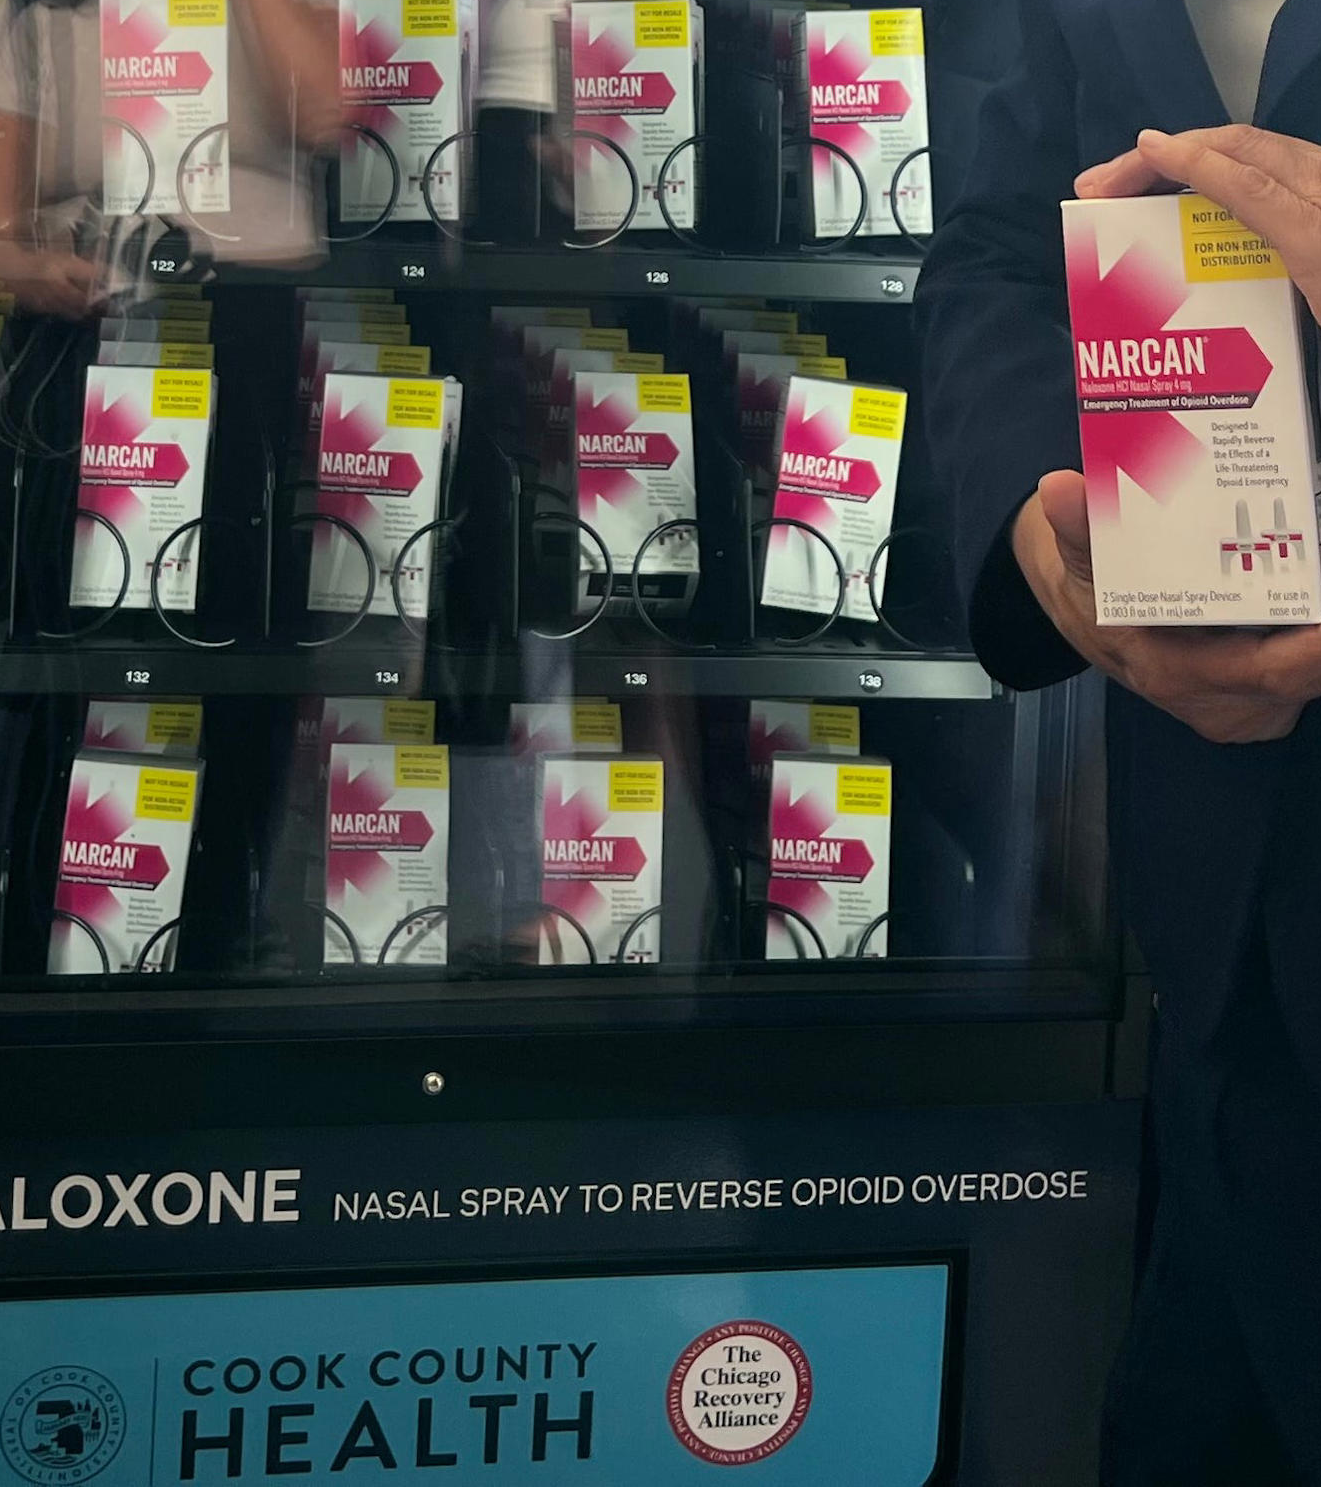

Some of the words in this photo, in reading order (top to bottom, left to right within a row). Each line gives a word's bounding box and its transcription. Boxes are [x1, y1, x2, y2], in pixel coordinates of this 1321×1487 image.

[104, 55, 177, 79] NARCAN
[341, 66, 411, 89] NARCAN
[574, 76, 643, 99] NARCAN
[811, 82, 881, 107] NARCAN
[1192, 212, 1211, 223] NOT
[1194, 243, 1214, 253] FOR
[150, 259, 175, 273] 122
[1201, 254, 1271, 267] DISTRIBUTION
[401, 265, 426, 279] 124
[646, 271, 670, 285] 126
[880, 280, 905, 293] 128
[1078, 337, 1206, 379] NARCAN
[1082, 381, 1115, 394] Naloxone
[1130, 380, 1151, 392] Nasal
[1152, 379, 1173, 393] Spray
[1180, 382, 1192, 393] mg
[1084, 399, 1128, 411] Emergency
[1129, 398, 1170, 408] Treatment
[1171, 396, 1180, 407] of
[1181, 395, 1208, 408] Opioid
[1210, 394, 1249, 406] Overdose
[1211, 421, 1248, 433] Designed
[1250, 422, 1259, 430] to
[579, 434, 647, 454] NARCAN
[1213, 435, 1242, 447] Rapidly
[1244, 435, 1275, 444] Reverse
[82, 444, 155, 469] NARCAN
[1214, 450, 1227, 458] the
[1229, 449, 1254, 458] Effects
[1256, 448, 1264, 457] of
[321, 451, 389, 476] NARCAN
[781, 451, 851, 481] NARCAN
[1216, 476, 1243, 488] Opioid
[1245, 477, 1288, 488] Emergency
[1160, 591, 1183, 602] Nasal
[1185, 591, 1208, 604] Spray
[1210, 591, 1243, 602] Devices
[1268, 589, 1282, 601] For
[1284, 592, 1298, 601] use
[1300, 590, 1309, 600] in
[1185, 605, 1204, 617] each
[1270, 608, 1289, 616] nose
[1292, 604, 1310, 618] only
[125, 670, 150, 684] 132
[375, 672, 400, 685] 134
[624, 673, 648, 686] 136
[858, 675, 882, 688] 138
[331, 813, 401, 834] NARCAN
[63, 840, 136, 869] NARCAN
[544, 840, 614, 863] NARCAN
[772, 838, 842, 863] NARCAN
[333, 1191, 450, 1222] NASAL
[459, 1186, 570, 1218] SPRAY
[579, 1184, 624, 1213] TO
[631, 1179, 784, 1212] REVERSE
[791, 1175, 904, 1206] OPIOID
[911, 1169, 1089, 1204] OVERDOSE
[723, 1346, 762, 1363] The
[183, 1353, 346, 1396] COOK
[369, 1342, 597, 1386] COUNTY
[701, 1367, 781, 1388] Chicago
[693, 1390, 787, 1409] Recovery
[698, 1411, 779, 1429] Alliance
[179, 1390, 595, 1480] HEALTH
